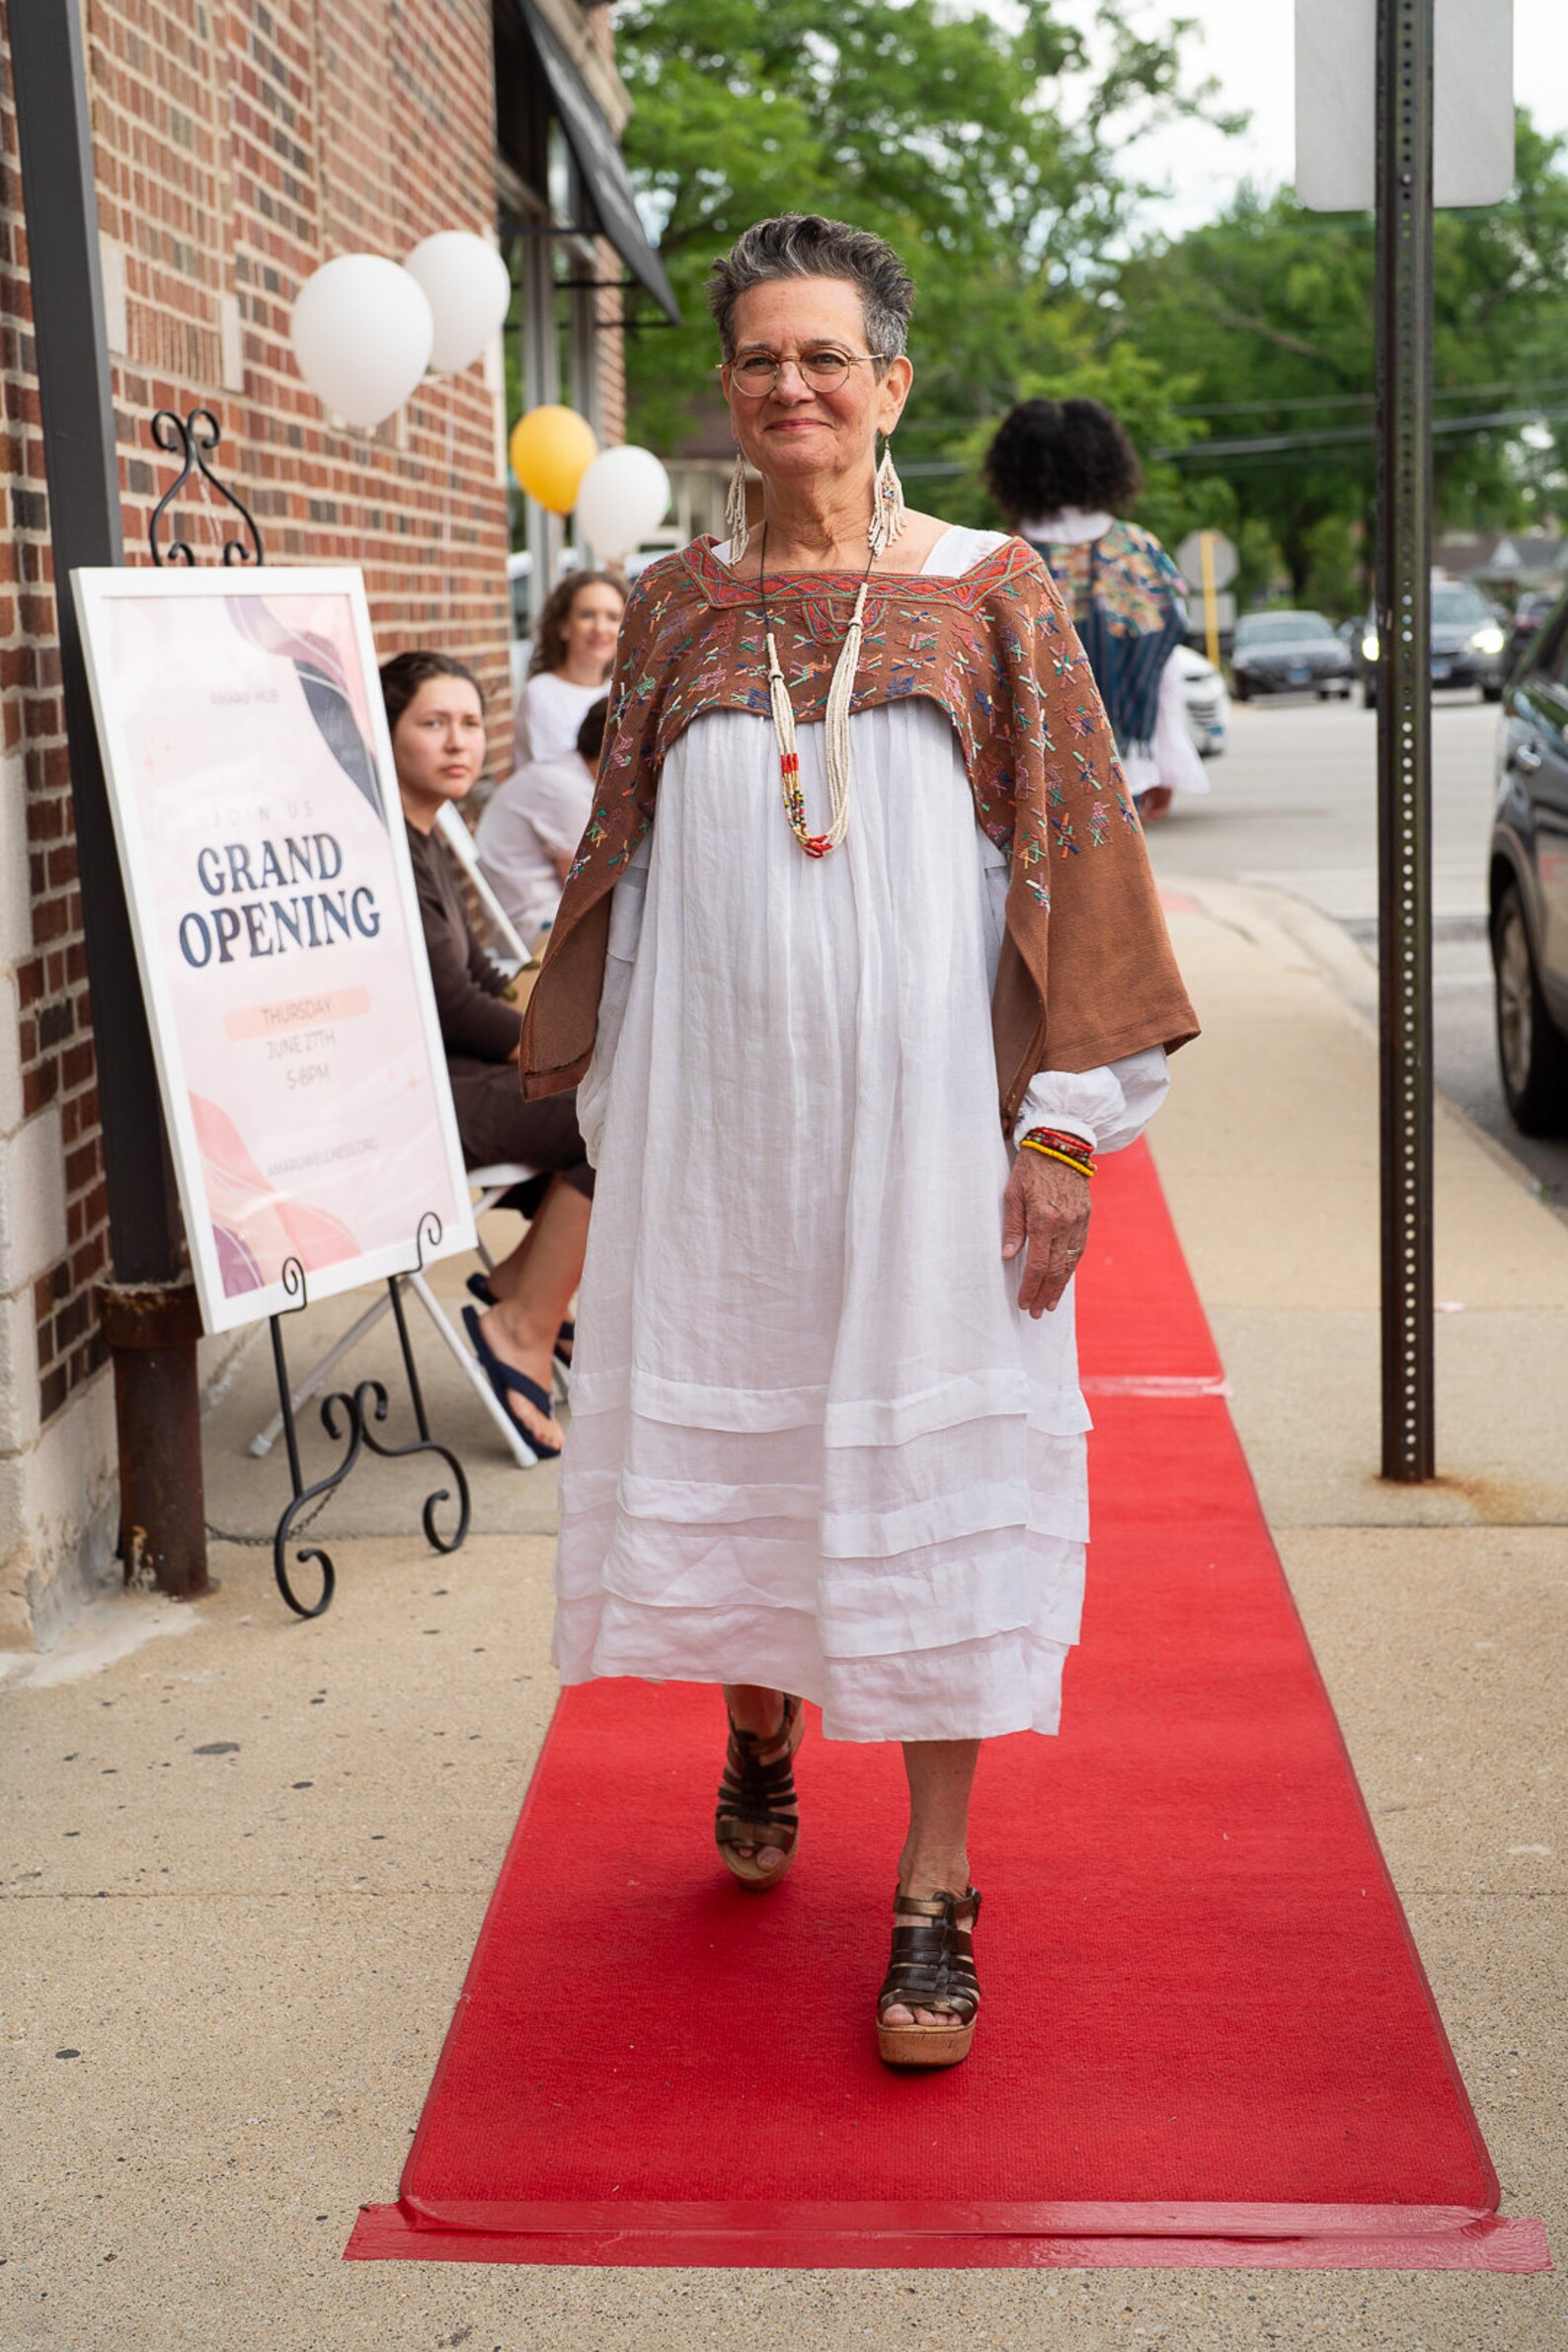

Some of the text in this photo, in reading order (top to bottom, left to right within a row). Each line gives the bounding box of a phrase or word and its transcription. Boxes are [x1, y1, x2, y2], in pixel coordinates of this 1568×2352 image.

[213, 800, 314, 828] JOIN US
[196, 832, 343, 897] GRAND
[179, 886, 381, 969] OPENING
[262, 996, 334, 1026] THURSDAY
[267, 1028, 337, 1060] JUNE 27TH
[286, 1062, 331, 1090] 5-8PM
